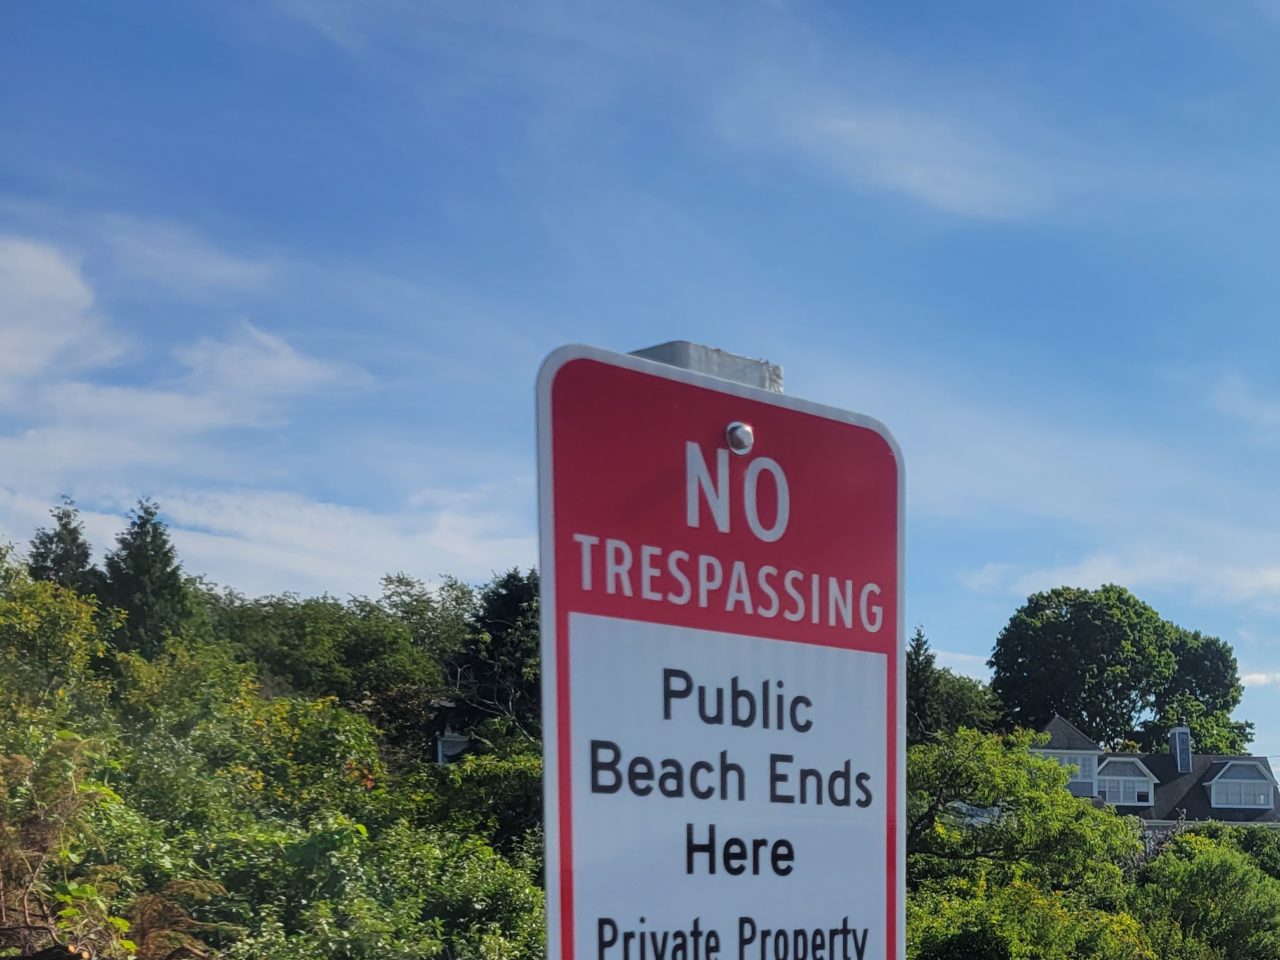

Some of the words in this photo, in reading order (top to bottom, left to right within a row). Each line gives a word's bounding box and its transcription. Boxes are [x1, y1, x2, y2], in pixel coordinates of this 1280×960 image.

[686, 440, 790, 542] NO
[573, 533, 883, 633] TRESPASSING
[663, 668, 813, 733] Public
[590, 740, 746, 801] Beach
[769, 753, 873, 809] Ends
[686, 823, 794, 876] Here
